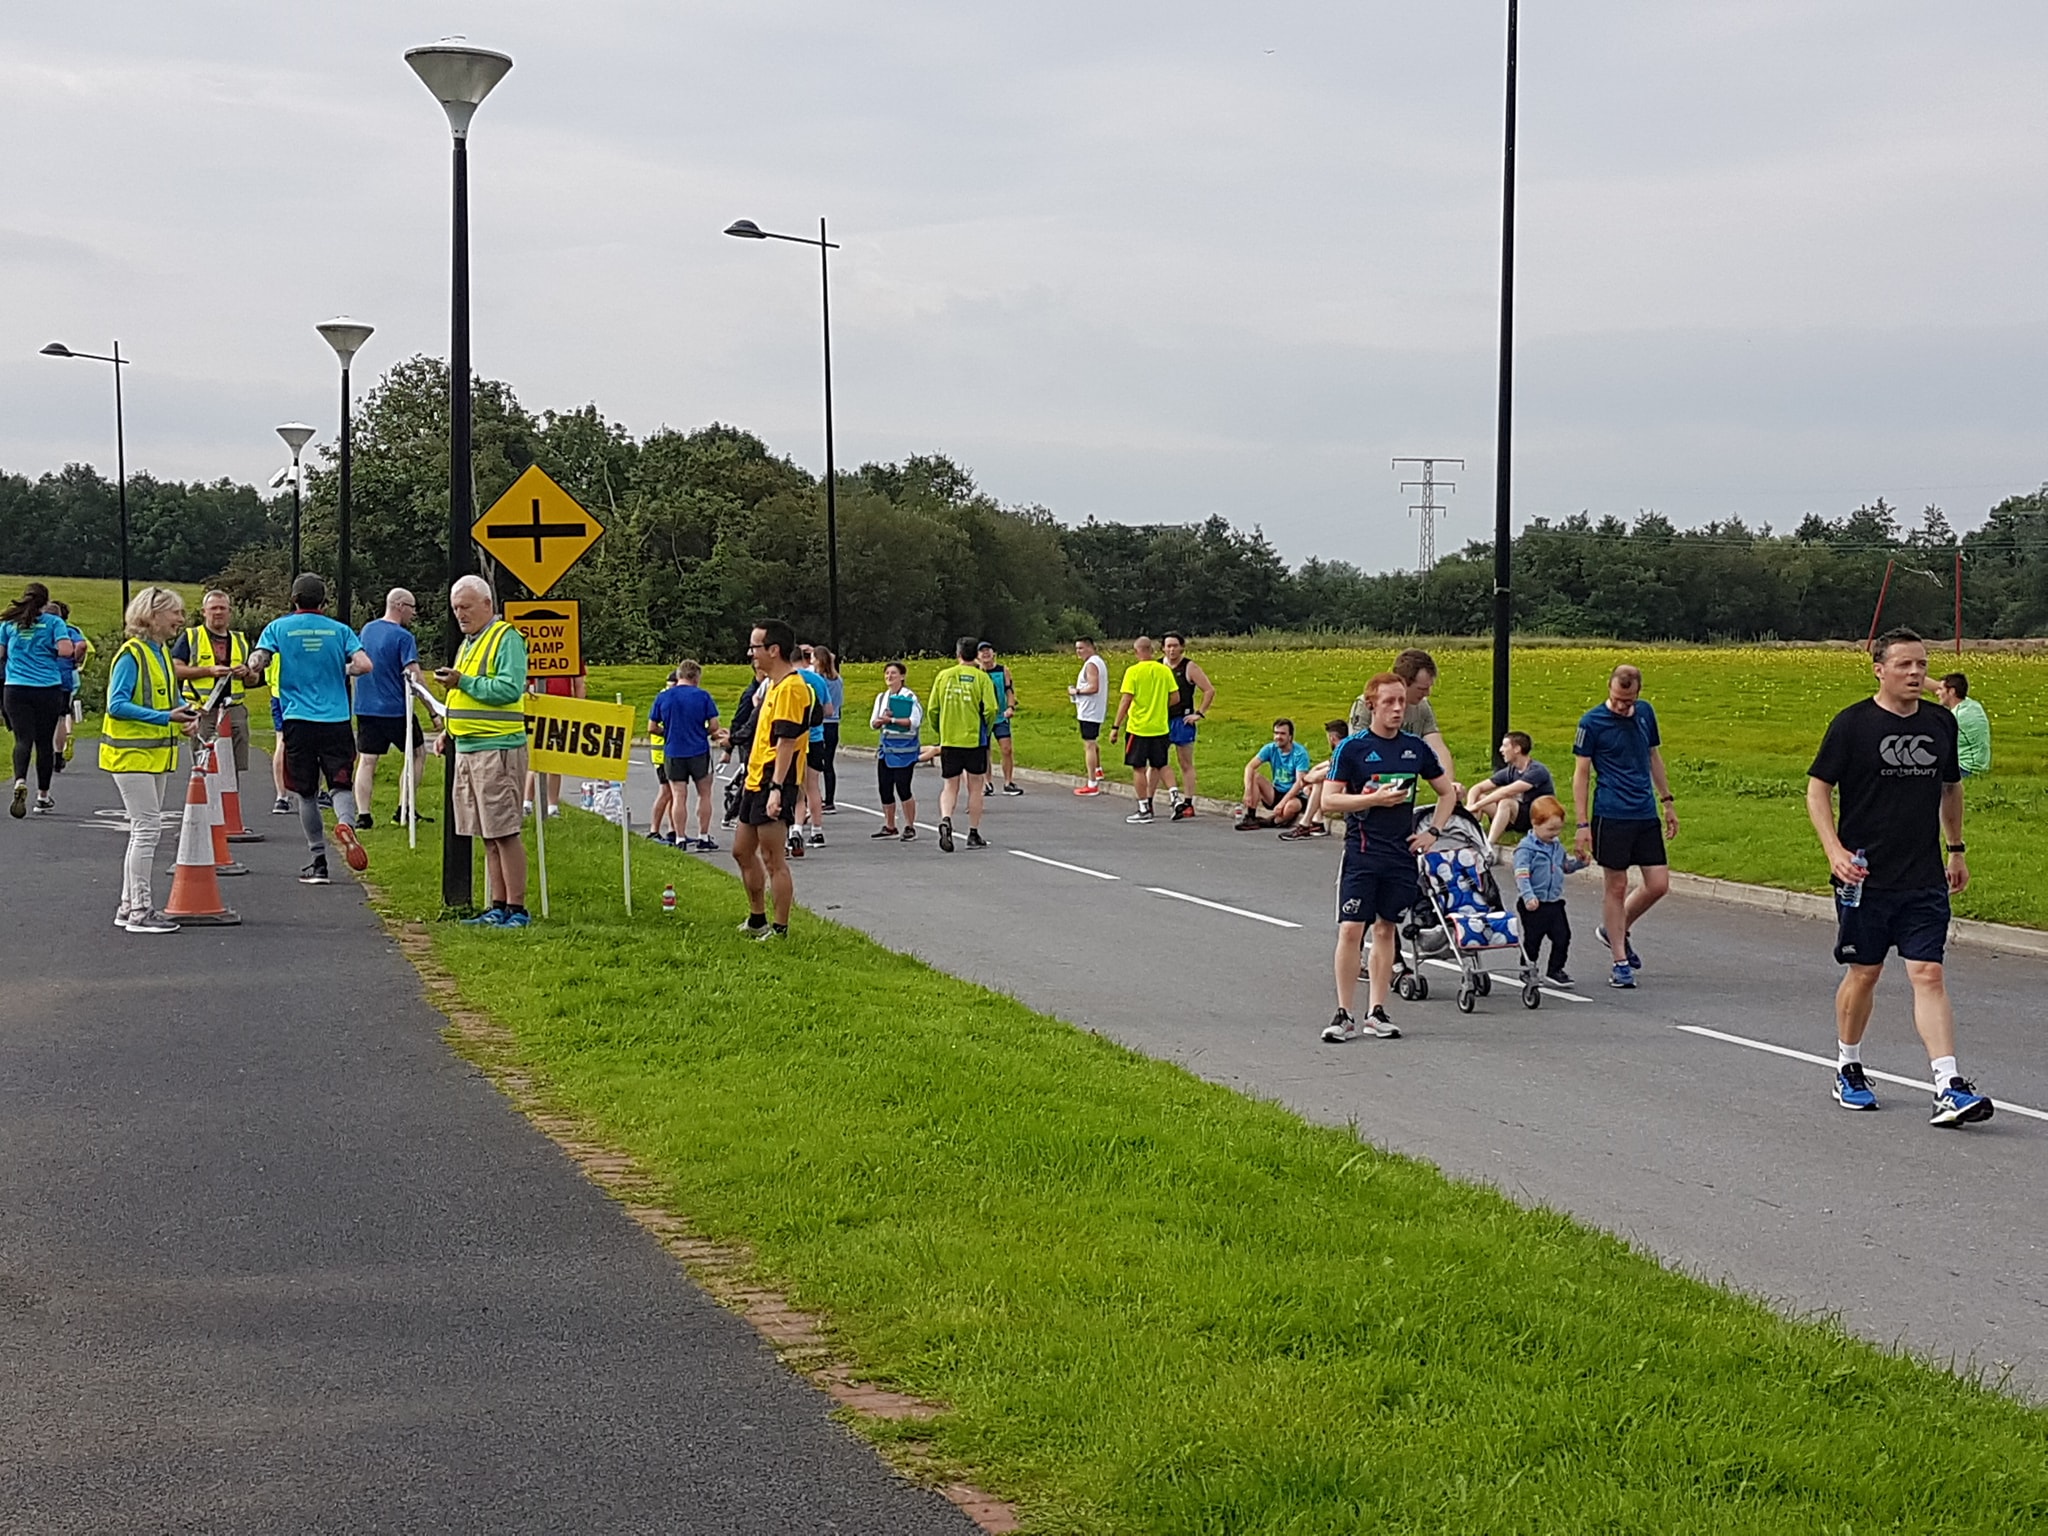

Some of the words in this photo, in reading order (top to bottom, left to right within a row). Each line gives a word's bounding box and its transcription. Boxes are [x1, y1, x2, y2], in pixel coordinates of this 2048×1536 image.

[520, 625, 565, 638] SLOW
[527, 640, 564, 654] AMP
[527, 657, 570, 670] HEAD
[523, 714, 626, 760] FINISH
